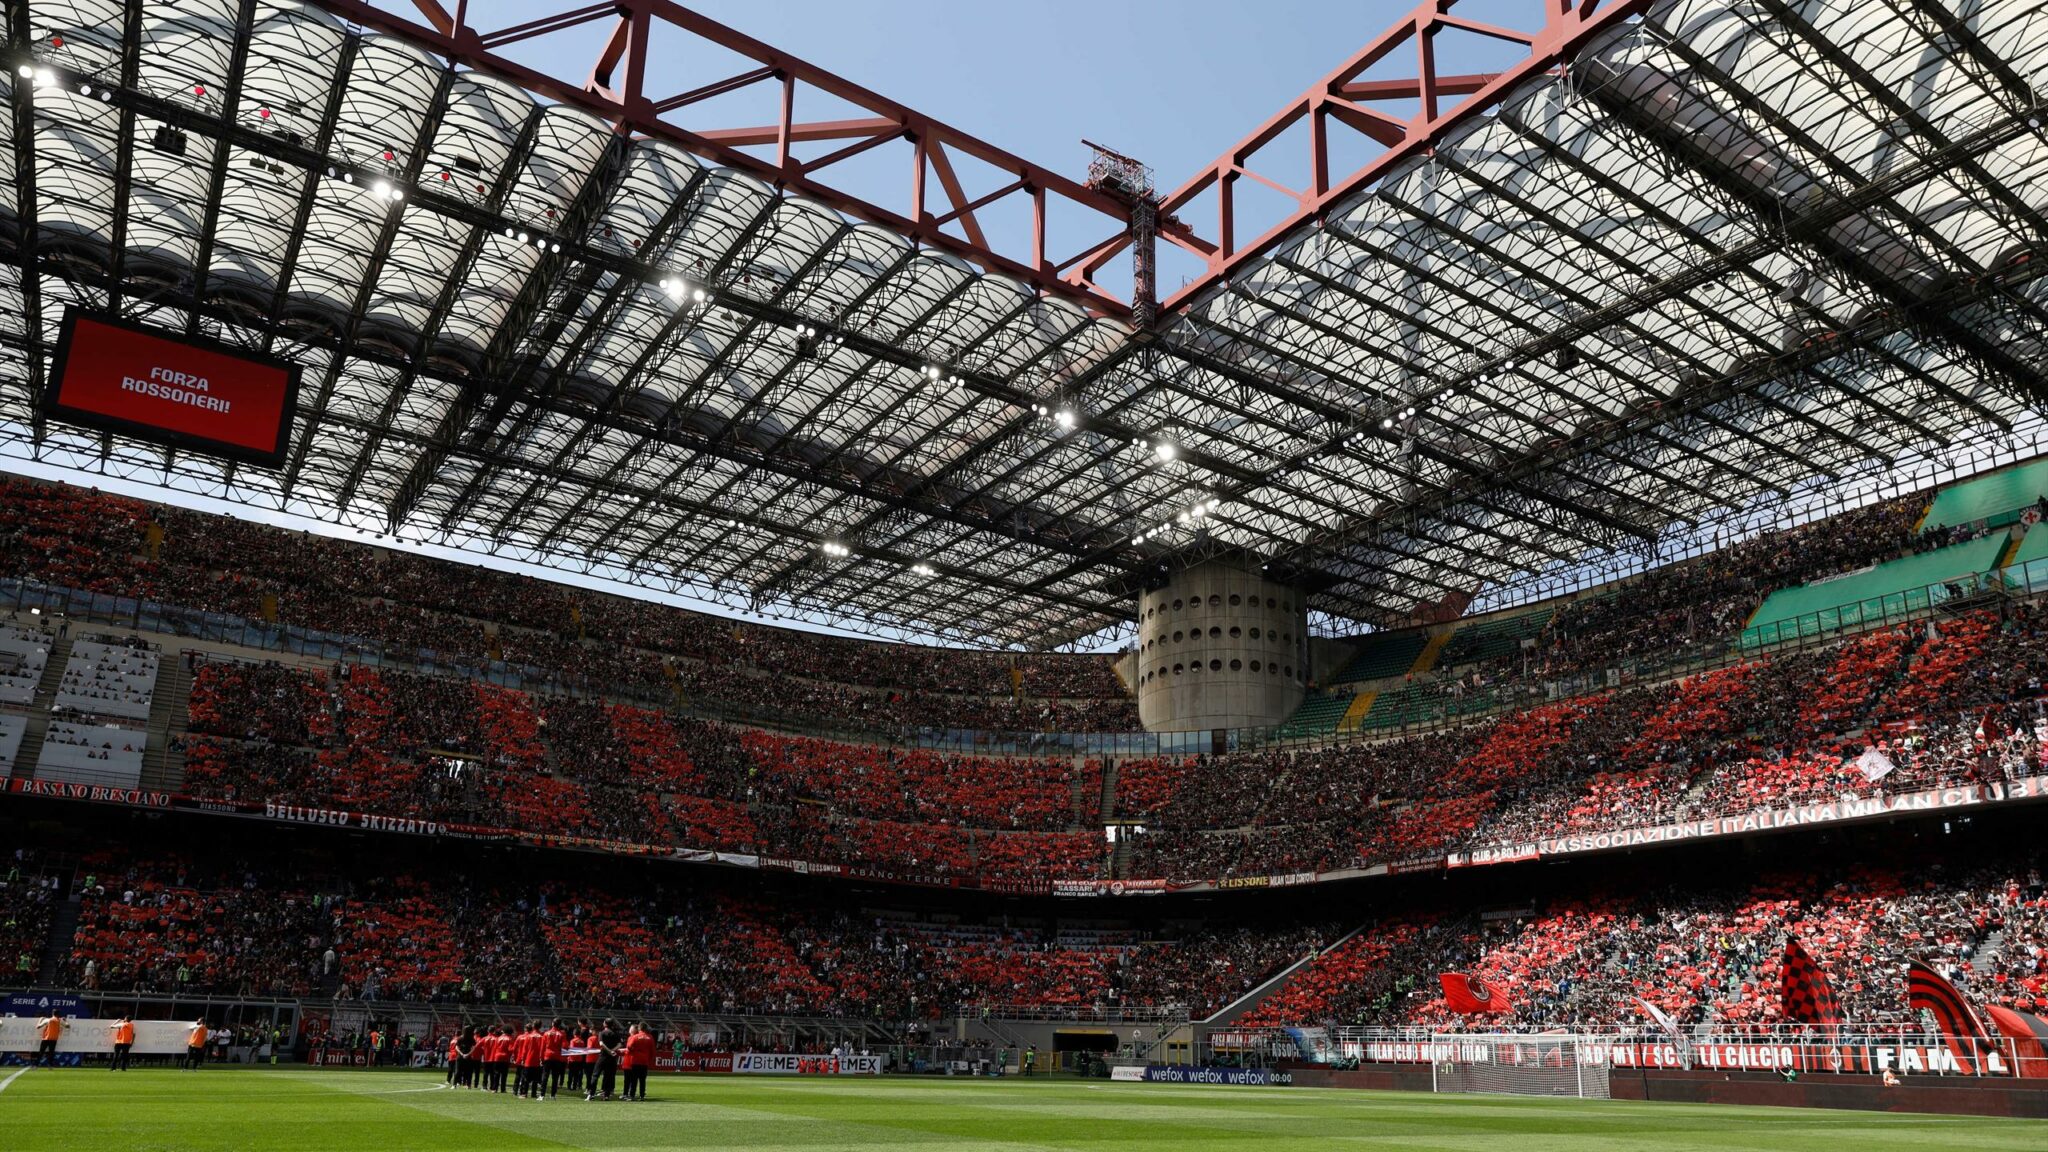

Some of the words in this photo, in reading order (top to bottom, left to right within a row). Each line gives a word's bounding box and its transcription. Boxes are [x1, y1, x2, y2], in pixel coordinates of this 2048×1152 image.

[150, 366, 209, 392] FORZA
[121, 376, 231, 413] ROSSONERI!
[22, 780, 88, 798] BASSANO
[90, 786, 169, 807] BRESCIANO
[265, 803, 349, 825] BELLUSCO
[360, 814, 436, 834] SKIZZATO
[1554, 822, 1715, 854] ASSOCIAZIONE
[1722, 806, 1838, 834] ITALIANA
[1844, 791, 1932, 818] MILAN
[1448, 852, 1470, 865] MILAN
[1472, 850, 1491, 863] CLUB
[1501, 844, 1536, 859] BOLZANO
[850, 867, 893, 880] ABANO
[906, 874, 951, 885] TERME
[1228, 877, 1269, 888] LISSONE
[12, 997, 37, 1006] SERIE
[61, 999, 77, 1007] TIM
[1211, 1033, 1225, 1047] CASA
[1367, 1042, 1393, 1060] MILAN
[1395, 1043, 1418, 1060] CLUB
[1725, 1045, 1794, 1067] CALCIO
[709, 1057, 731, 1068] BETTER
[1151, 1066, 1184, 1081] wefox
[1188, 1067, 1223, 1083] wefox
[1228, 1068, 1265, 1085] wefox
[1270, 1072, 1292, 1083] 00:00
